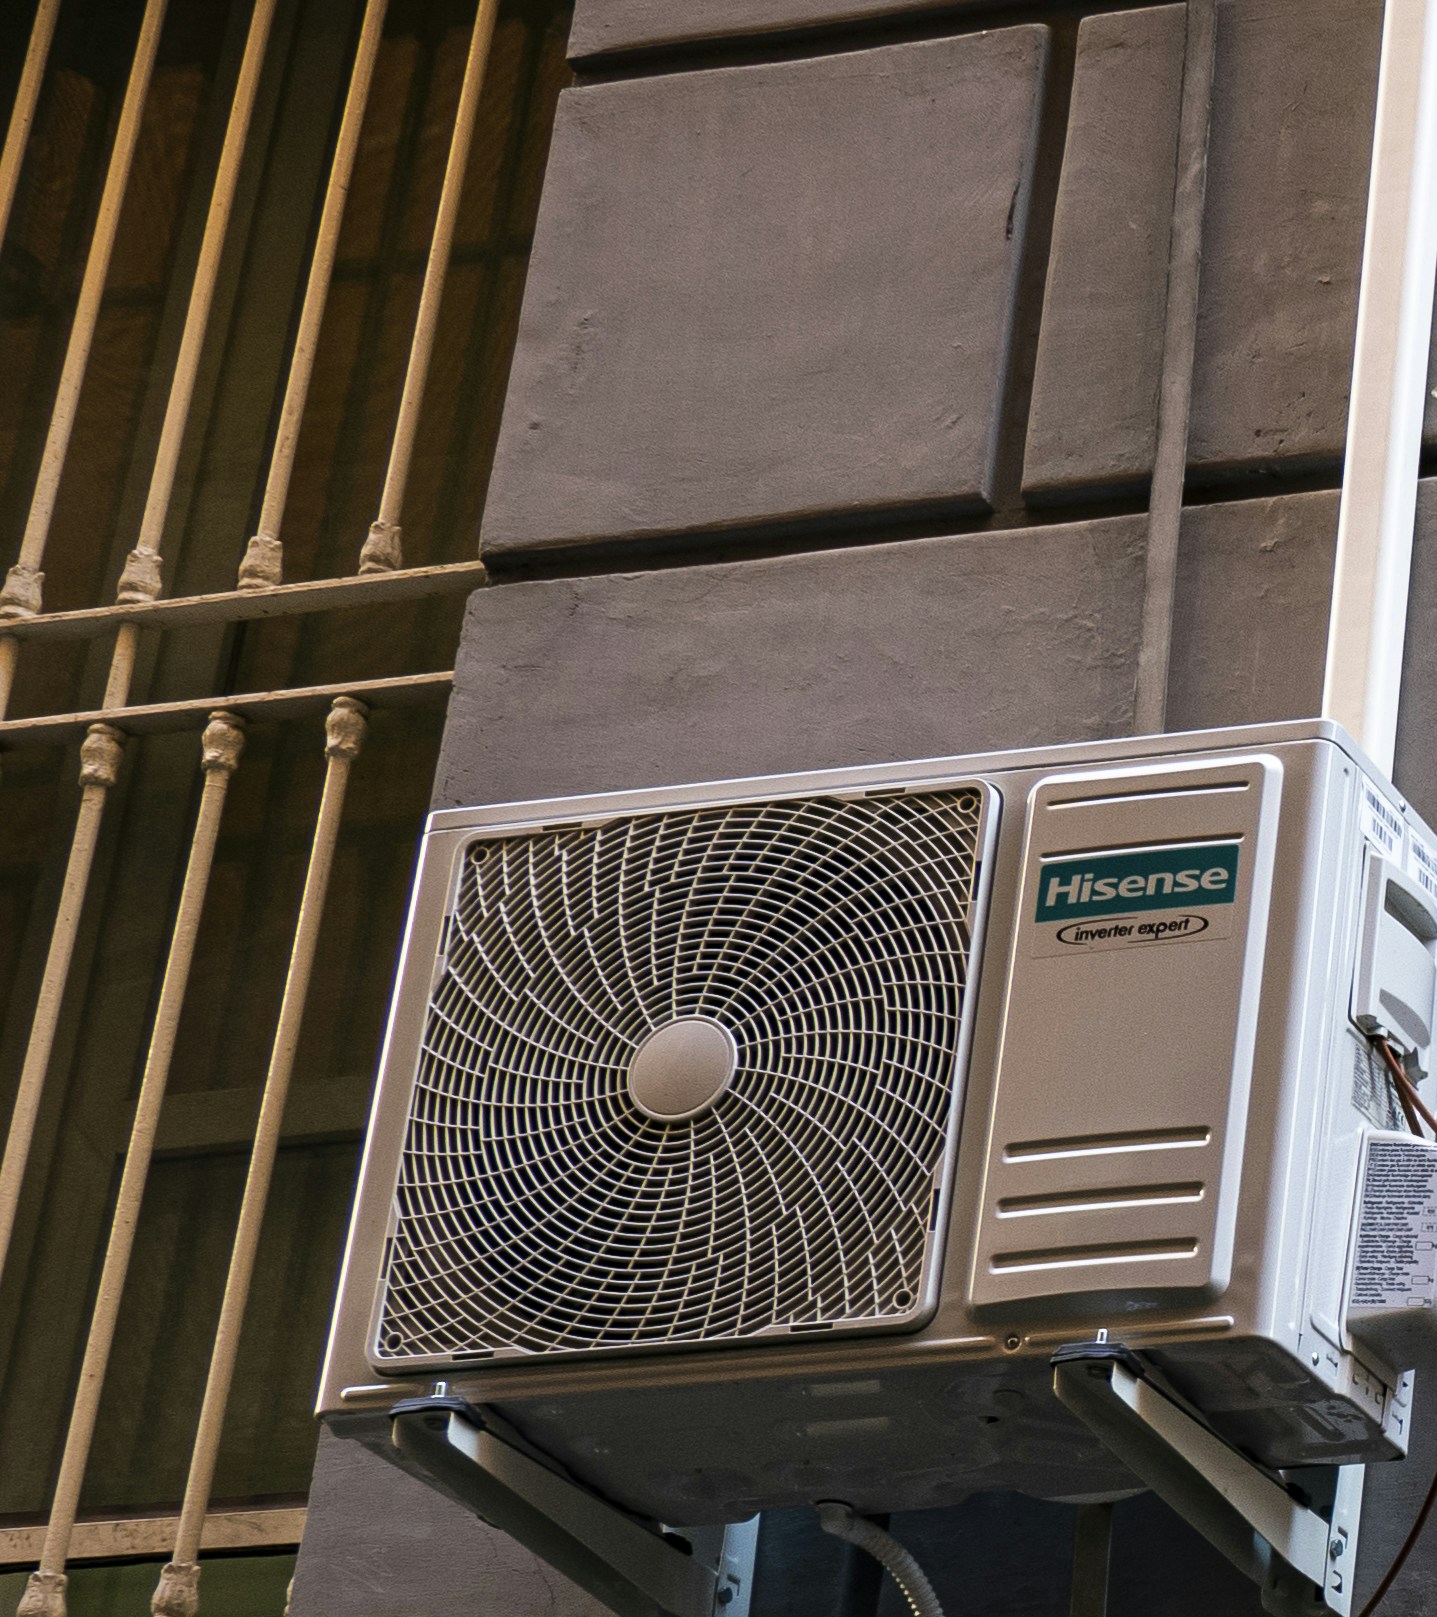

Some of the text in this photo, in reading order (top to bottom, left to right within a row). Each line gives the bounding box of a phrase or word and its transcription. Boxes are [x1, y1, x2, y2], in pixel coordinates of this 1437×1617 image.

[1045, 867, 1229, 907] Hisense
[1074, 917, 1189, 942] inverter expert
